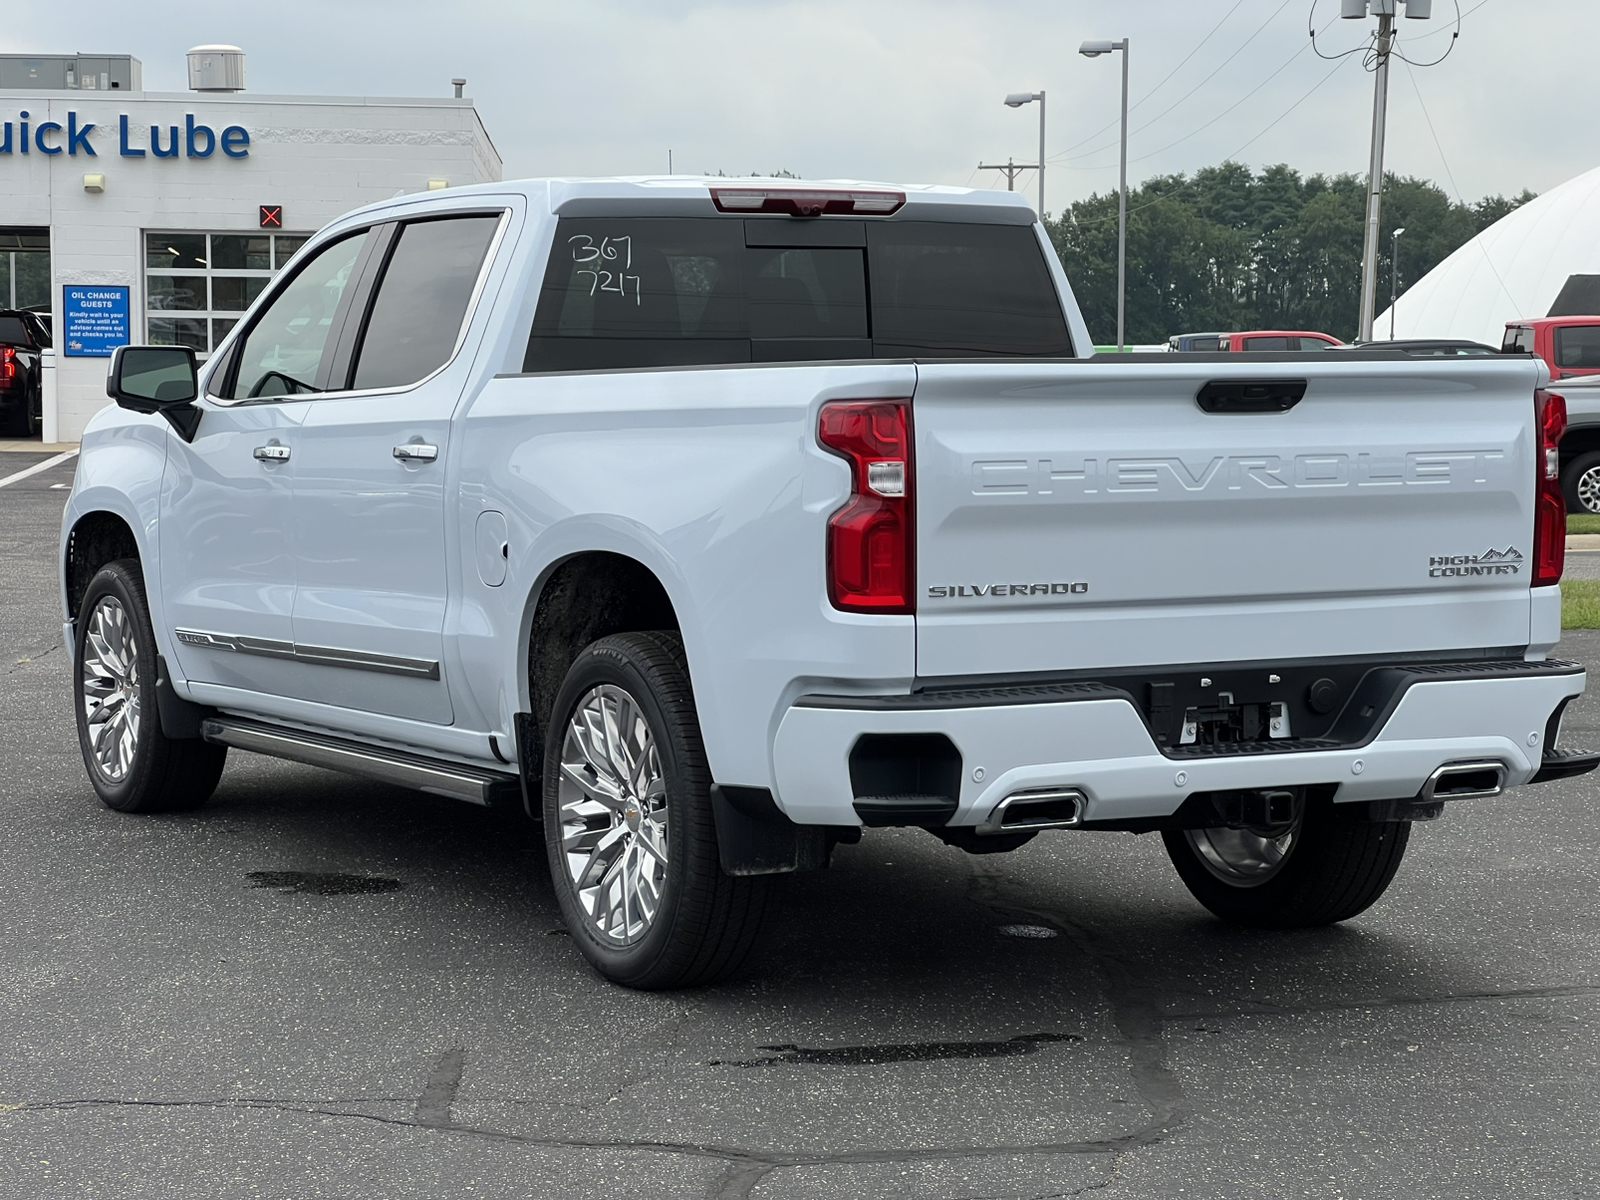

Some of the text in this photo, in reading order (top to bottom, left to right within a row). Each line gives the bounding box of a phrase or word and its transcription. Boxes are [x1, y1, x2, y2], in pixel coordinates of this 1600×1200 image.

[119, 114, 250, 158] Lube
[87, 292, 122, 300] CHANGE
[577, 270, 641, 306] 7217
[971, 449, 1504, 496] CHEVROLET
[1429, 555, 1479, 567] HIGH
[1429, 563, 1523, 578] COUNTRY
[928, 582, 1089, 598] SILVERADO
